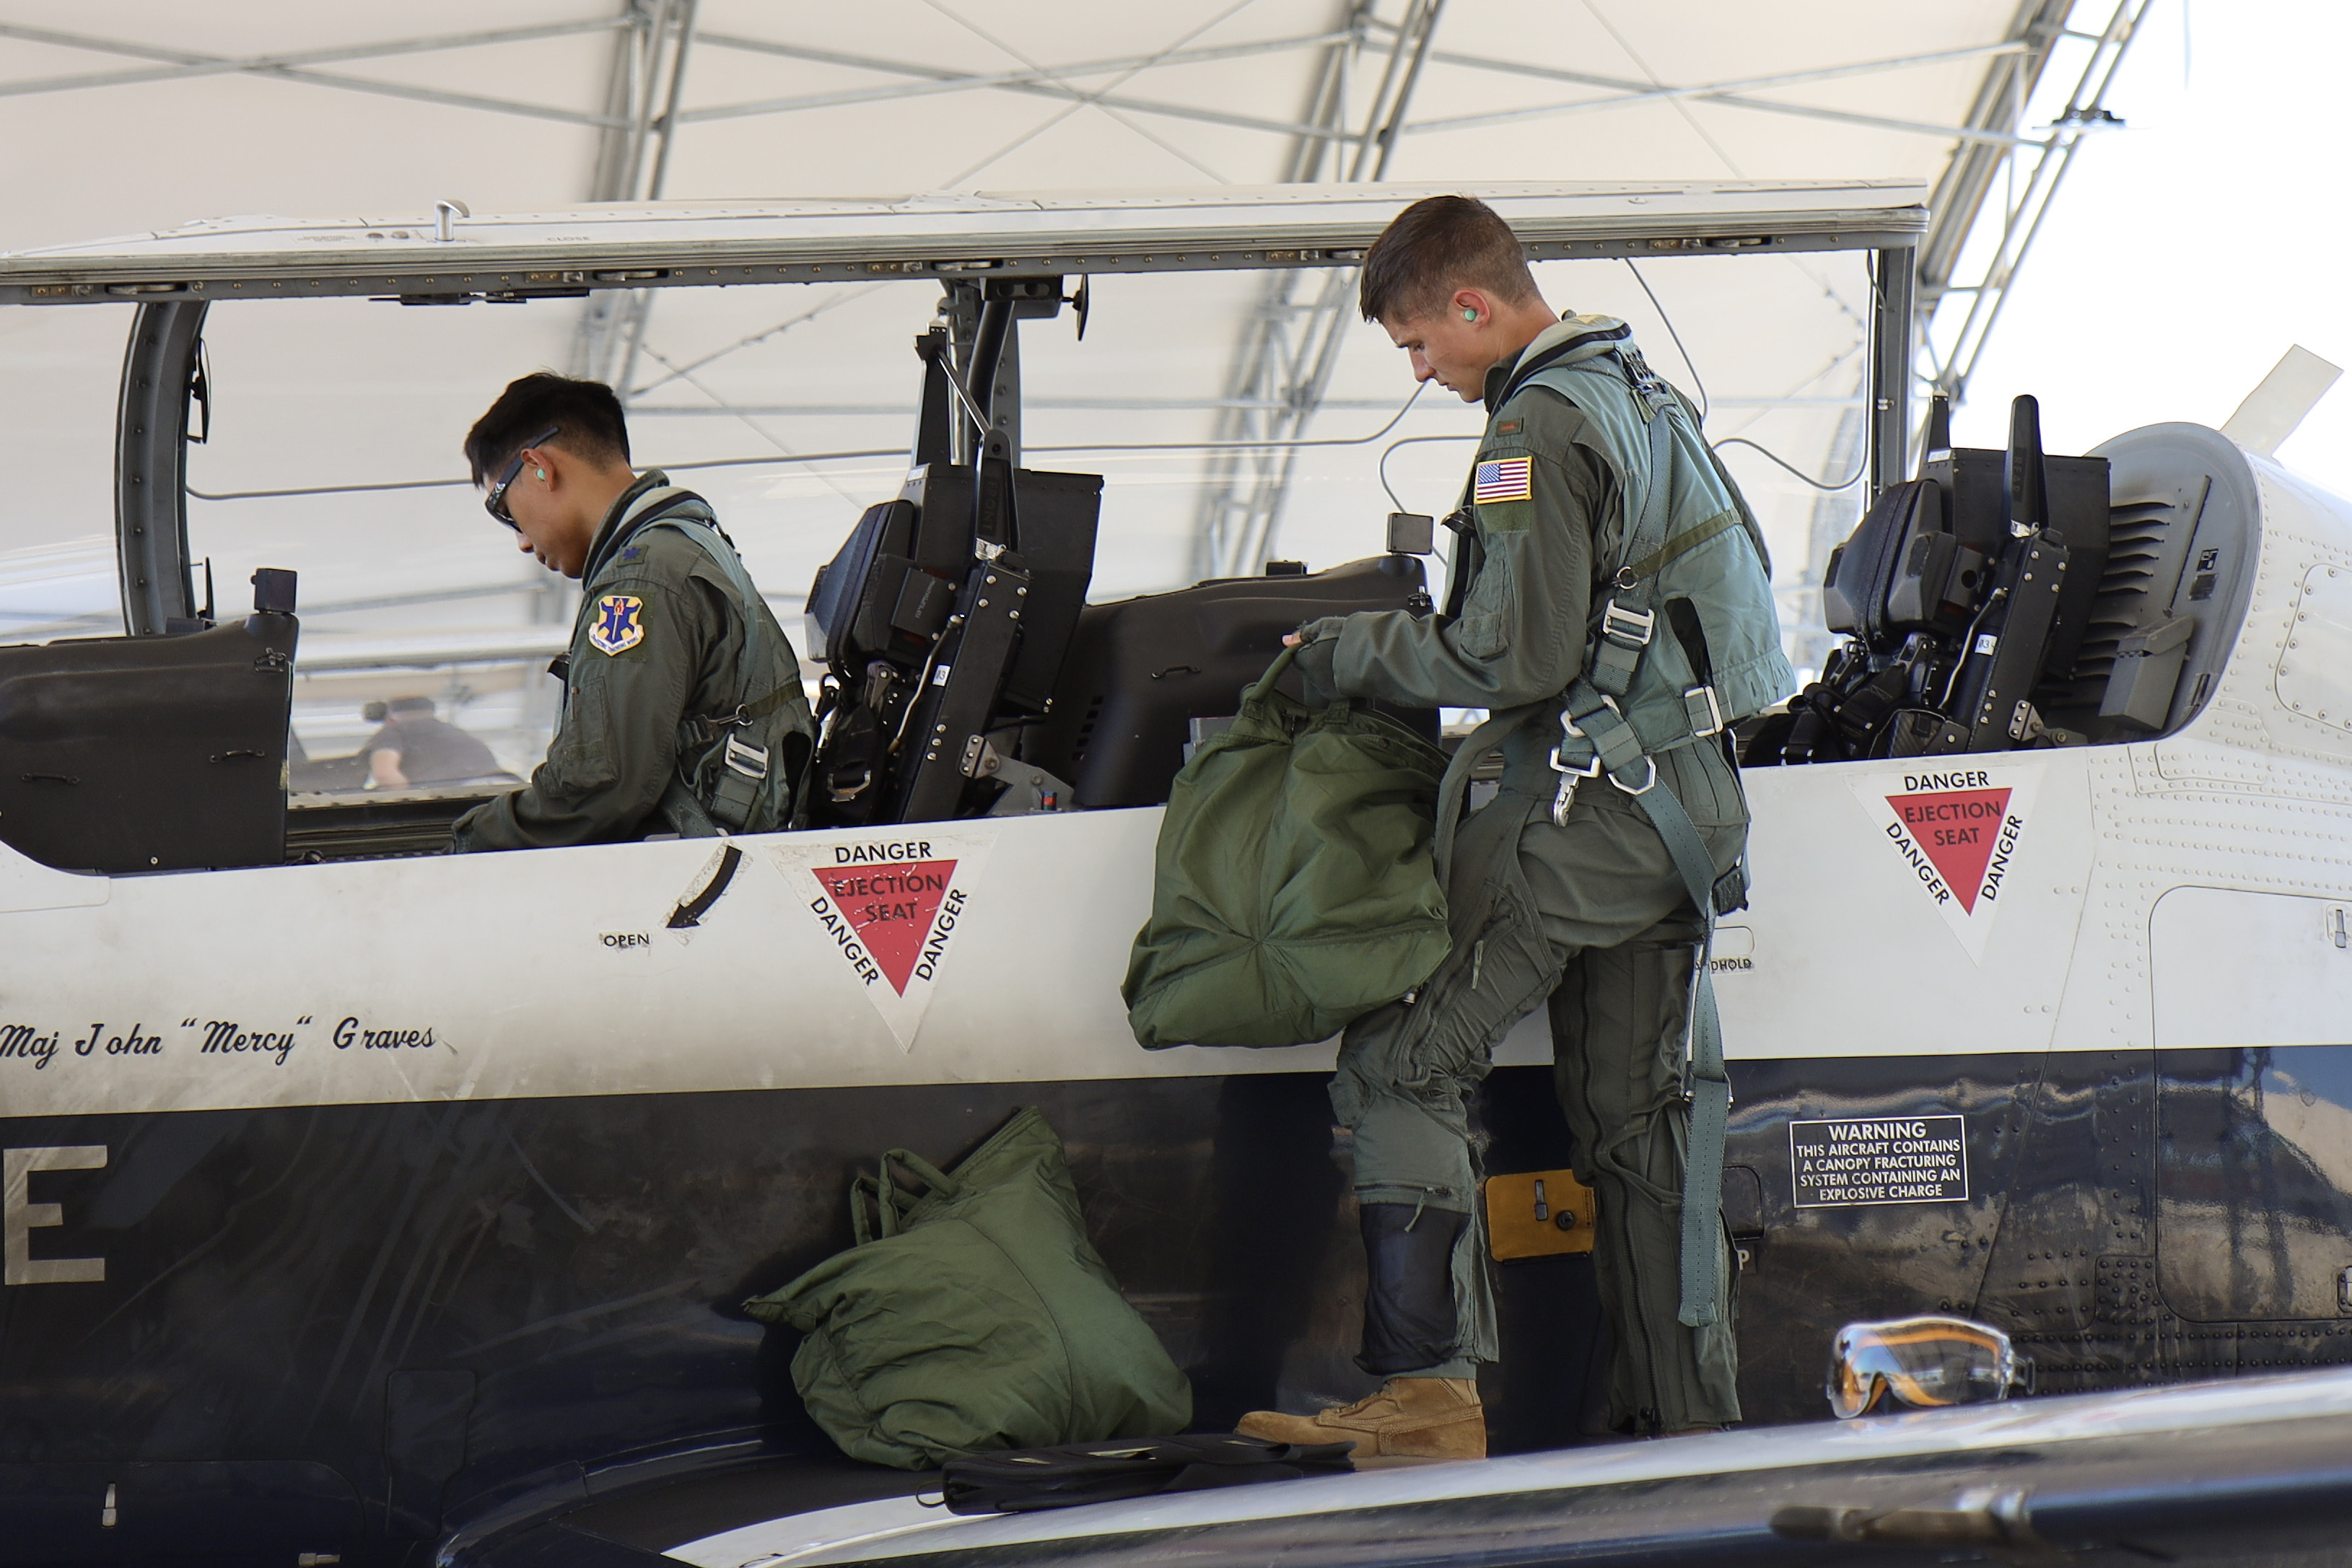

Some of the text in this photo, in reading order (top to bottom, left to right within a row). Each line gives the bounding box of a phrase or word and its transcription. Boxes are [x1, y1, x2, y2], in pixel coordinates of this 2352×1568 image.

[1904, 771, 1990, 792] DANGER
[1905, 802, 2001, 823] EJECTION
[1934, 828, 1980, 846] SEAT
[836, 841, 932, 864] DANGER
[1981, 815, 2023, 901] DANGER
[1886, 822, 1949, 906] DANGER
[834, 874, 943, 898] EJECTION
[865, 902, 917, 923] SEAT
[603, 933, 650, 947] OPEN
[810, 896, 879, 987] DANGER
[915, 888, 968, 981] DANGER
[1695, 958, 1752, 971] DHOLD
[0, 1024, 59, 1070] Maj
[75, 1023, 162, 1057] John
[332, 1017, 436, 1050] Graves
[1828, 1121, 1926, 1141] WARNING
[1796, 1139, 1960, 1157] THIS AIRCRAFT CONTAINS
[1803, 1155, 1957, 1172] A CANOPY FRACTURING
[1800, 1168, 1960, 1187] SYSTEM CONTAINING AN
[1819, 1184, 1942, 1201] EXPLOSIVE CHARGE
[3, 1144, 108, 1286] E
